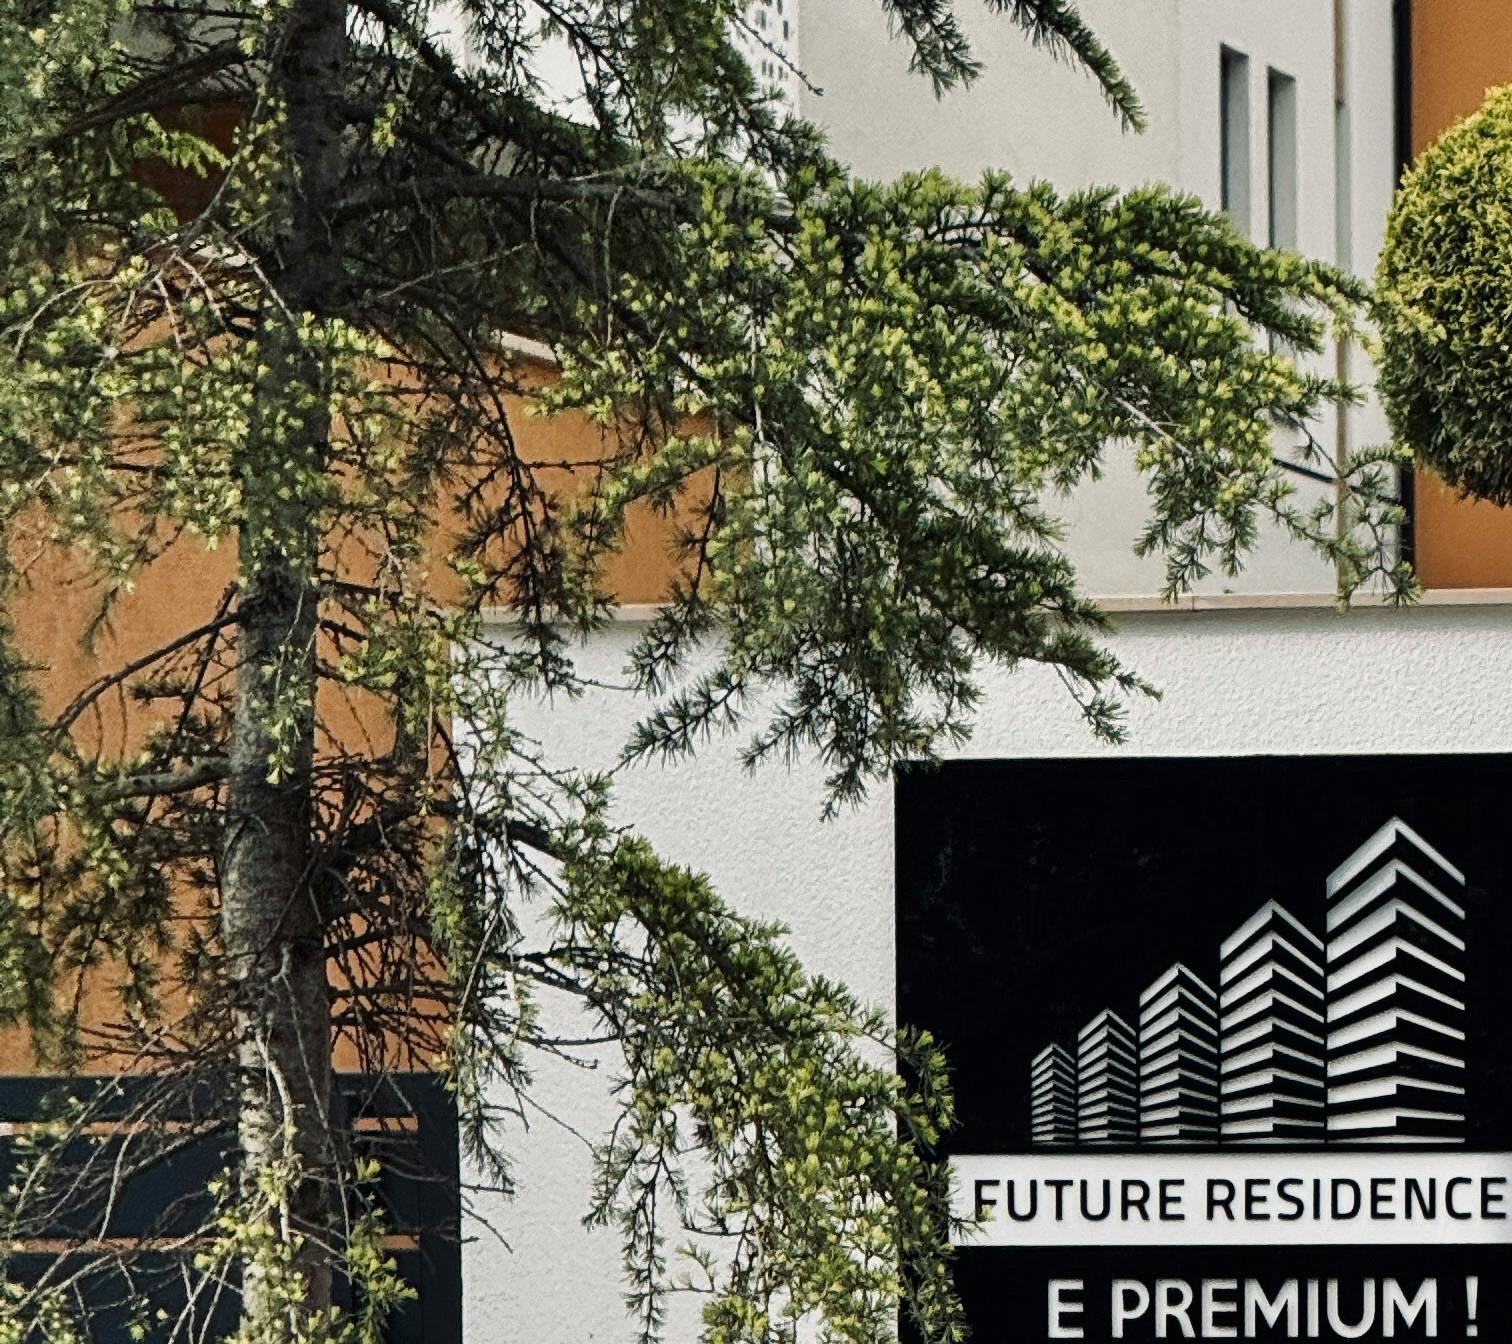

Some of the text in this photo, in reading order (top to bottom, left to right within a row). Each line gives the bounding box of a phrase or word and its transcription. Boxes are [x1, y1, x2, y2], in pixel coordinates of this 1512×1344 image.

[974, 1178, 1186, 1222] FUTURE
[1206, 1176, 1508, 1222] RESIDENCE
[1047, 1279, 1085, 1339] E
[1111, 1278, 1438, 1339] PREMIUM
